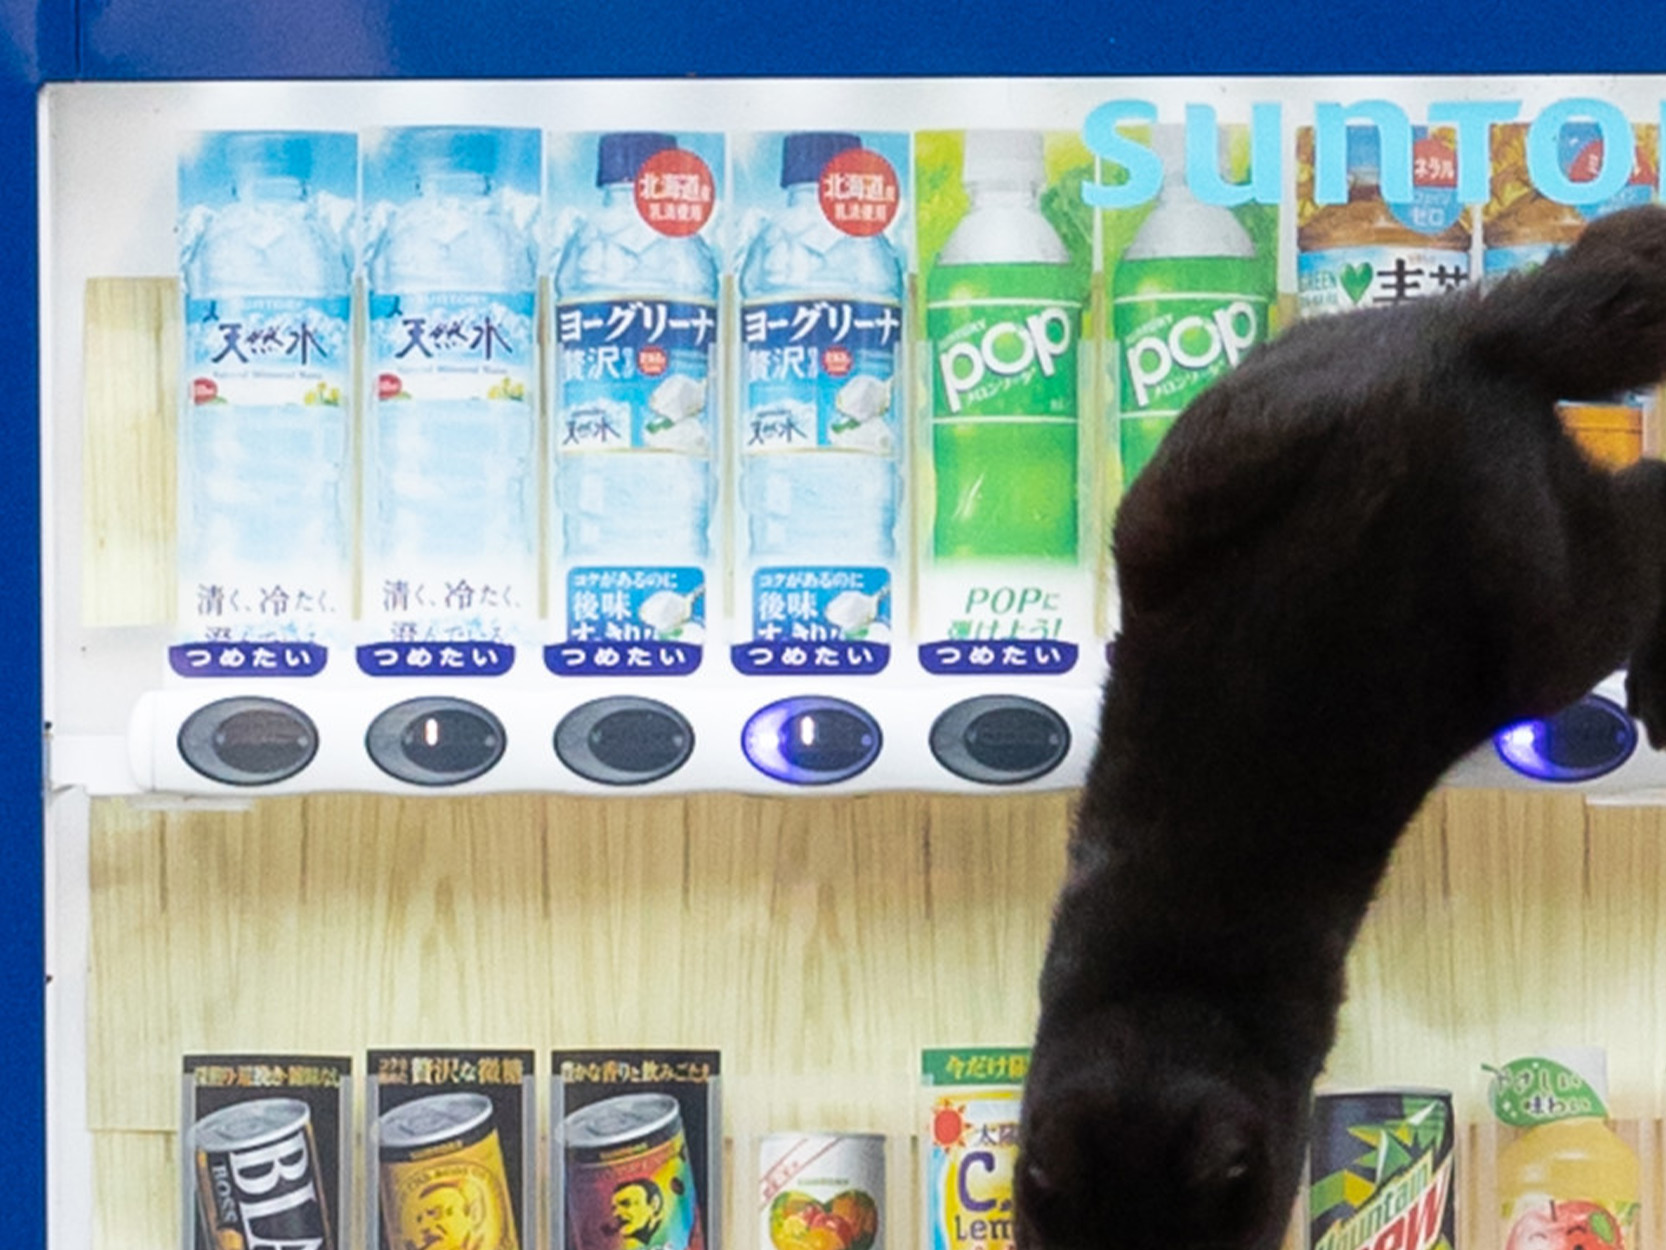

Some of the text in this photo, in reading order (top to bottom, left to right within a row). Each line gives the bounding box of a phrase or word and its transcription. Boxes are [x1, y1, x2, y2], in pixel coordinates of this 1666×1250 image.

[560, 301, 715, 346] ヨーグリーナ
[744, 301, 900, 346] ヨーグリーナ
[211, 322, 327, 366] 天然水
[395, 317, 513, 363] 天然水
[574, 572, 678, 589] コクがあるのに
[759, 572, 864, 589] コクがあるのに
[573, 590, 631, 621] 後味
[759, 590, 818, 621] 後味
[187, 646, 310, 668] つめたい
[374, 646, 498, 668] つめたい
[562, 646, 686, 667] つめたい
[749, 646, 874, 667] つめたい
[937, 645, 1061, 666] つめたい
[212, 1164, 238, 1223] BOSS
